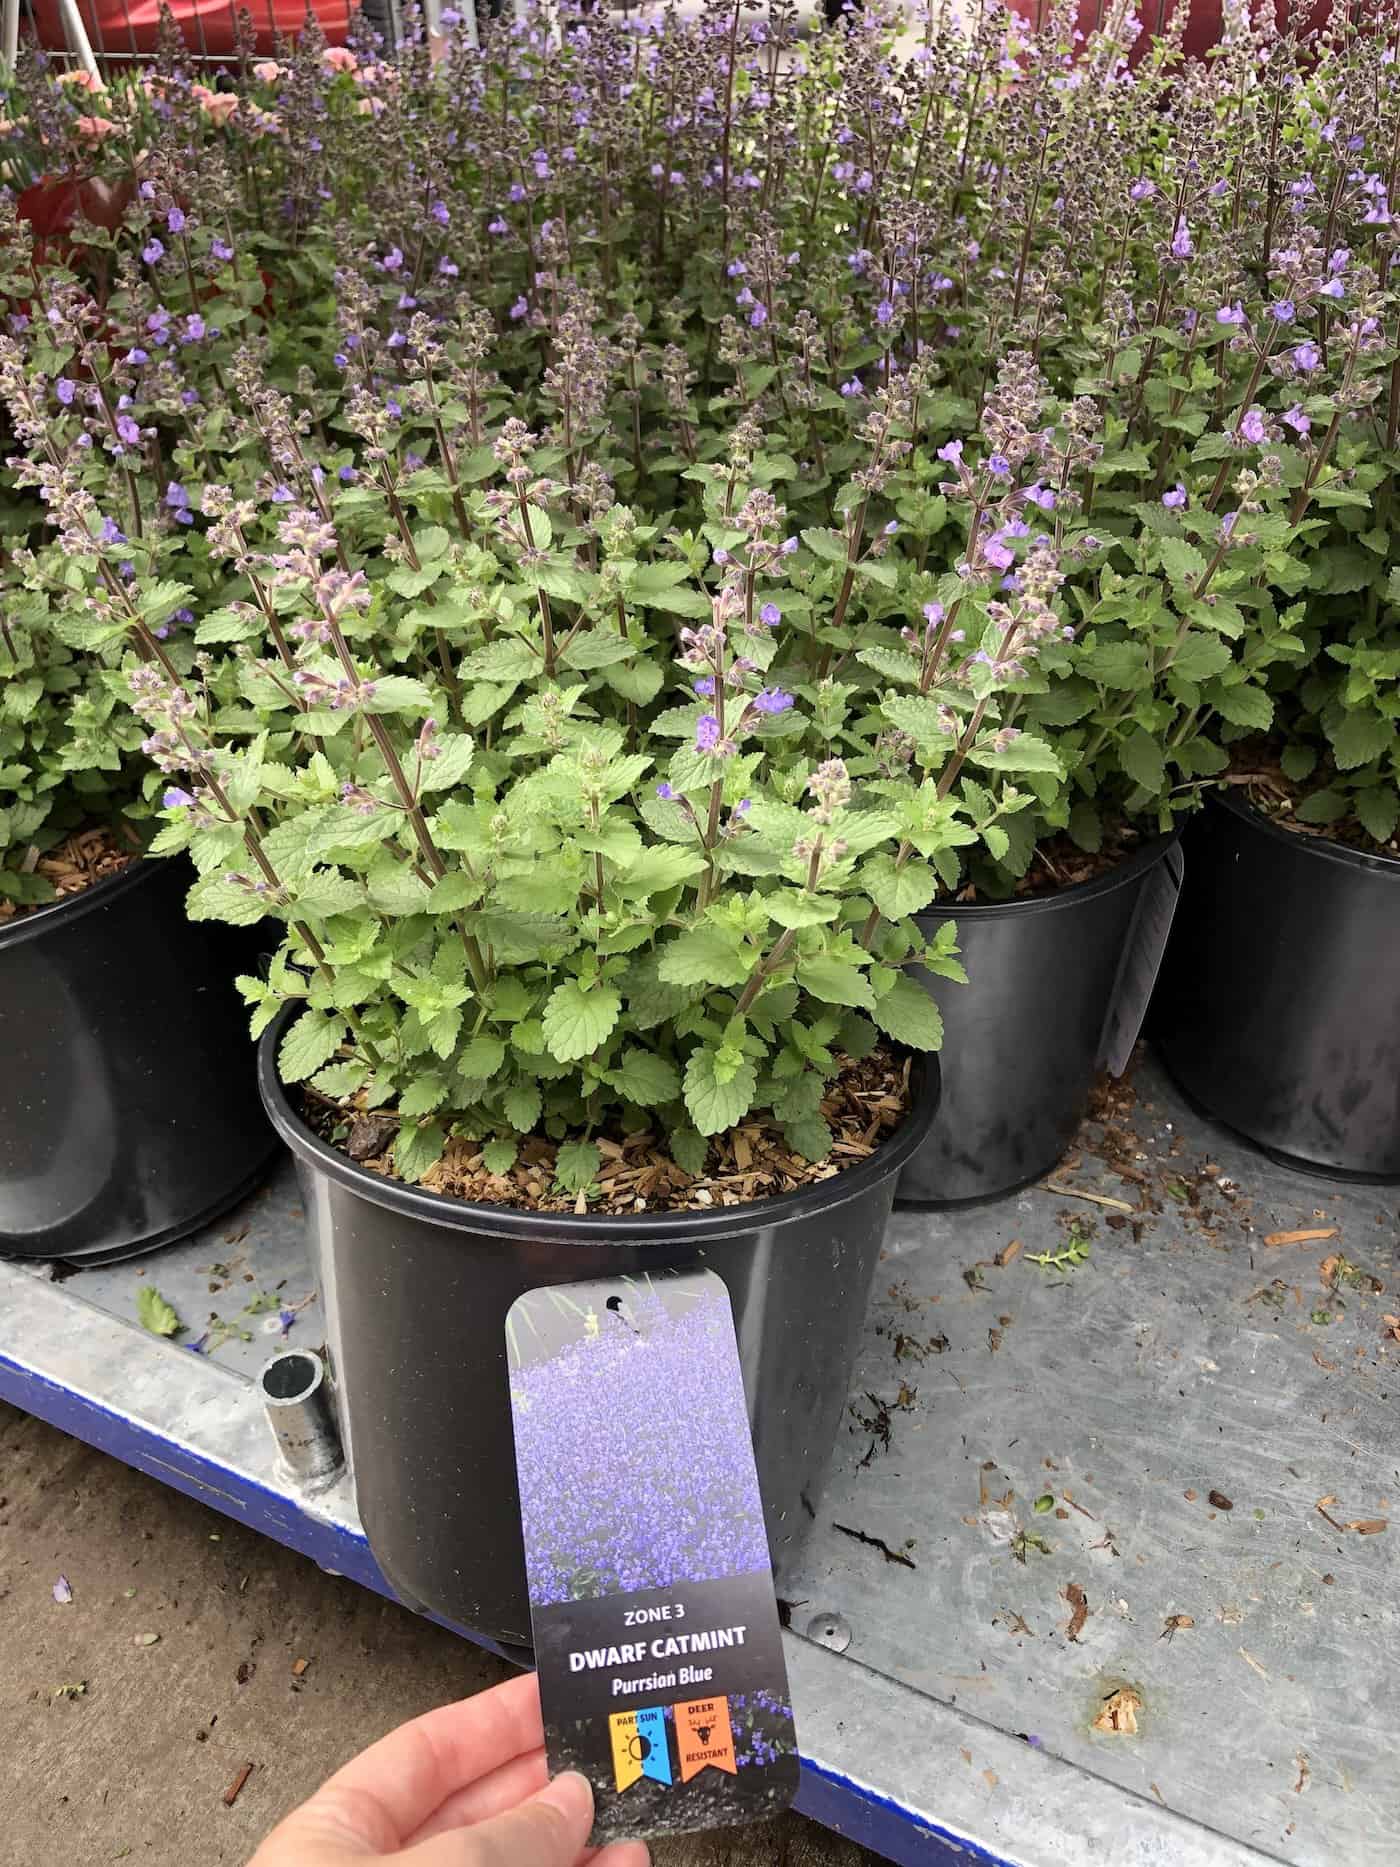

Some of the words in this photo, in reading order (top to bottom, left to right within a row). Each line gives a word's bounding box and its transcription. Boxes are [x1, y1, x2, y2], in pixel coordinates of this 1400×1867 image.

[624, 1606, 672, 1626] ZONE
[674, 1604, 686, 1619] 3
[569, 1642, 647, 1672] DWARF
[651, 1626, 747, 1659] CATMINT
[612, 1671, 676, 1697] Purrsian
[679, 1665, 713, 1685] Blue
[687, 1703, 715, 1715] DEER
[616, 1714, 639, 1727] PART
[640, 1713, 658, 1724] SUN
[686, 1748, 728, 1763] RESISTANT
